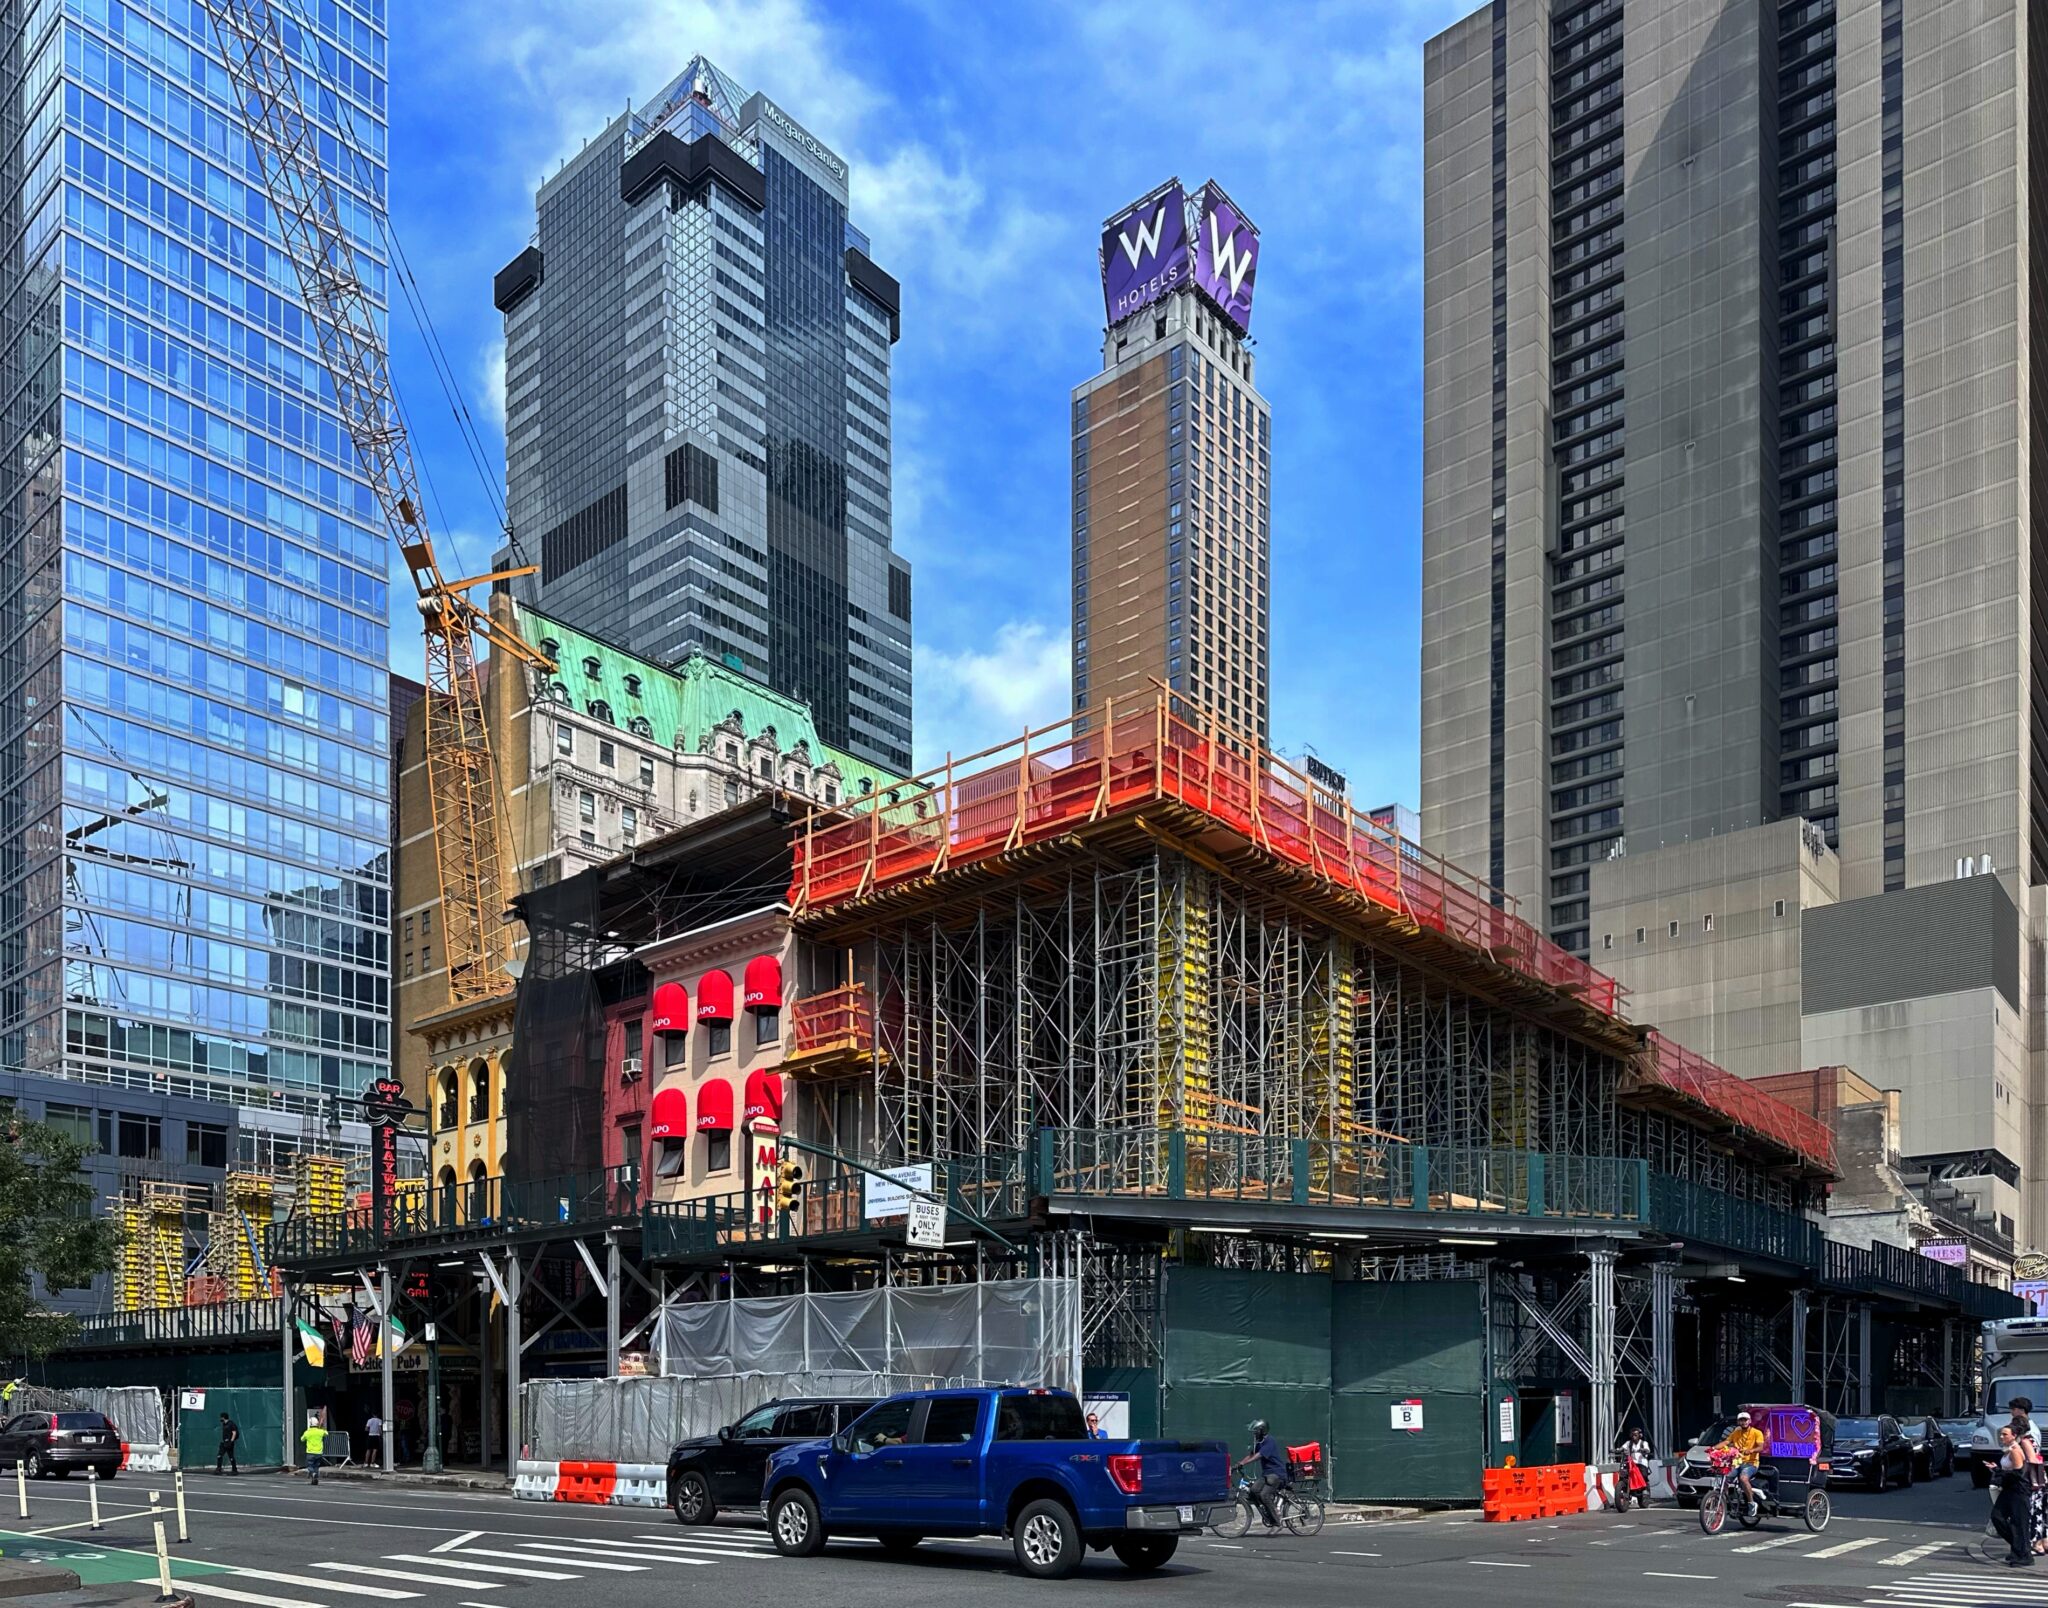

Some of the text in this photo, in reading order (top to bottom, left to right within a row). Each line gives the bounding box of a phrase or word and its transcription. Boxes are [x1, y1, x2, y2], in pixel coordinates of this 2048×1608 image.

[764, 101, 845, 180] Morgan Stanley
[1118, 206, 1166, 271] W
[1209, 210, 1253, 300] W
[1118, 266, 1179, 312] HOTELS
[1307, 755, 1346, 793] EDITION
[745, 992, 763, 1002] APO
[699, 1006, 716, 1015] APO
[653, 1018, 671, 1028] APO
[378, 1082, 401, 1094] BAR
[745, 1105, 765, 1115] APO
[697, 1116, 716, 1125] APO
[651, 1125, 670, 1135] APO
[916, 1204, 940, 1216] BUSES
[918, 1219, 936, 1230] ONLY
[1922, 1238, 1962, 1247] IMPERIAL
[1924, 1248, 1963, 1258] CHESS
[2016, 1256, 2047, 1269] Music
[397, 1354, 415, 1370] Pub
[190, 1396, 198, 1405] D
[1403, 1411, 1412, 1422] B
